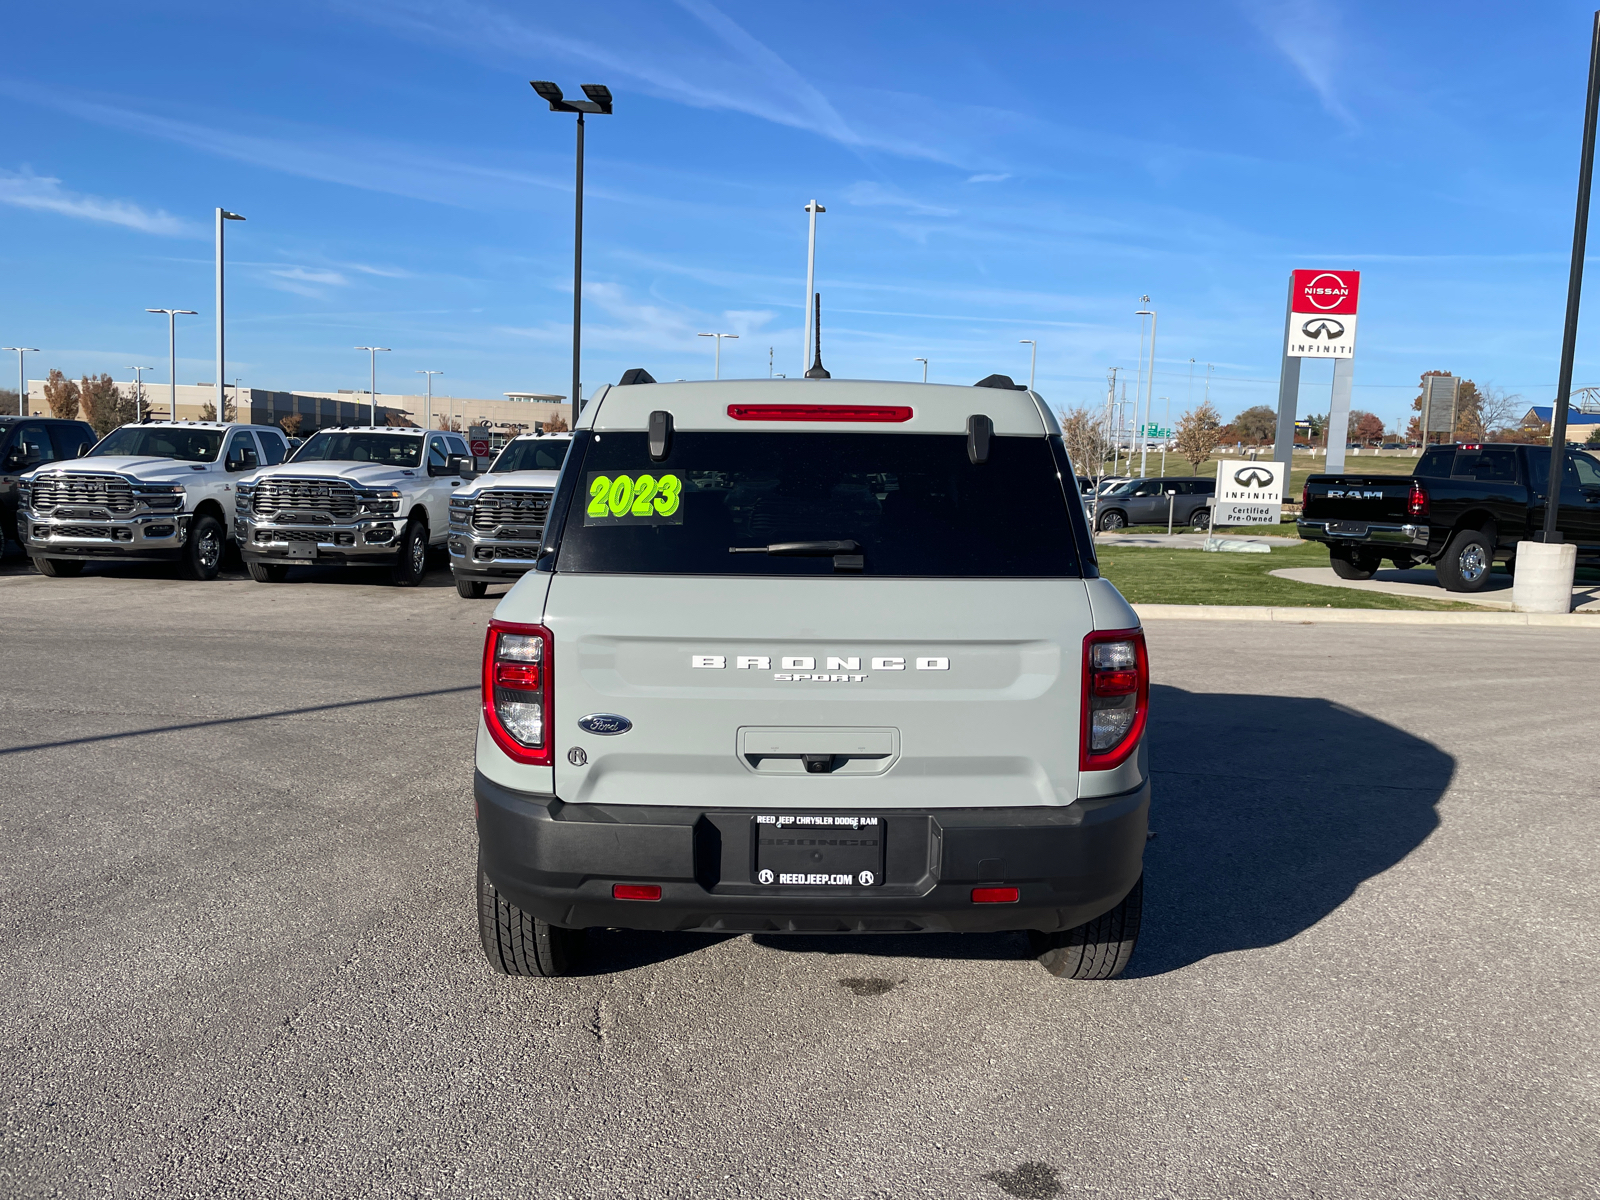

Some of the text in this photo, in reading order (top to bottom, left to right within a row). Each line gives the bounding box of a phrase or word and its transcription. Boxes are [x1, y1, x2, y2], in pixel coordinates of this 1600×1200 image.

[1304, 287, 1349, 296] NISSAN
[1291, 344, 1352, 354] INFINITI
[587, 474, 682, 518] 2023
[1225, 491, 1279, 500] INFINITI
[1327, 489, 1383, 500] RAM
[1232, 506, 1270, 515] Certified
[1227, 514, 1273, 523] Pre-Owned
[692, 655, 951, 670] BRONCO
[773, 673, 868, 682] SPORT
[590, 717, 619, 731] Ford
[757, 815, 878, 826] REED JEEP CHRYSLER DODGE RAM
[760, 839, 879, 847] BRONCO
[779, 873, 853, 885] REEDJEEP.COM
